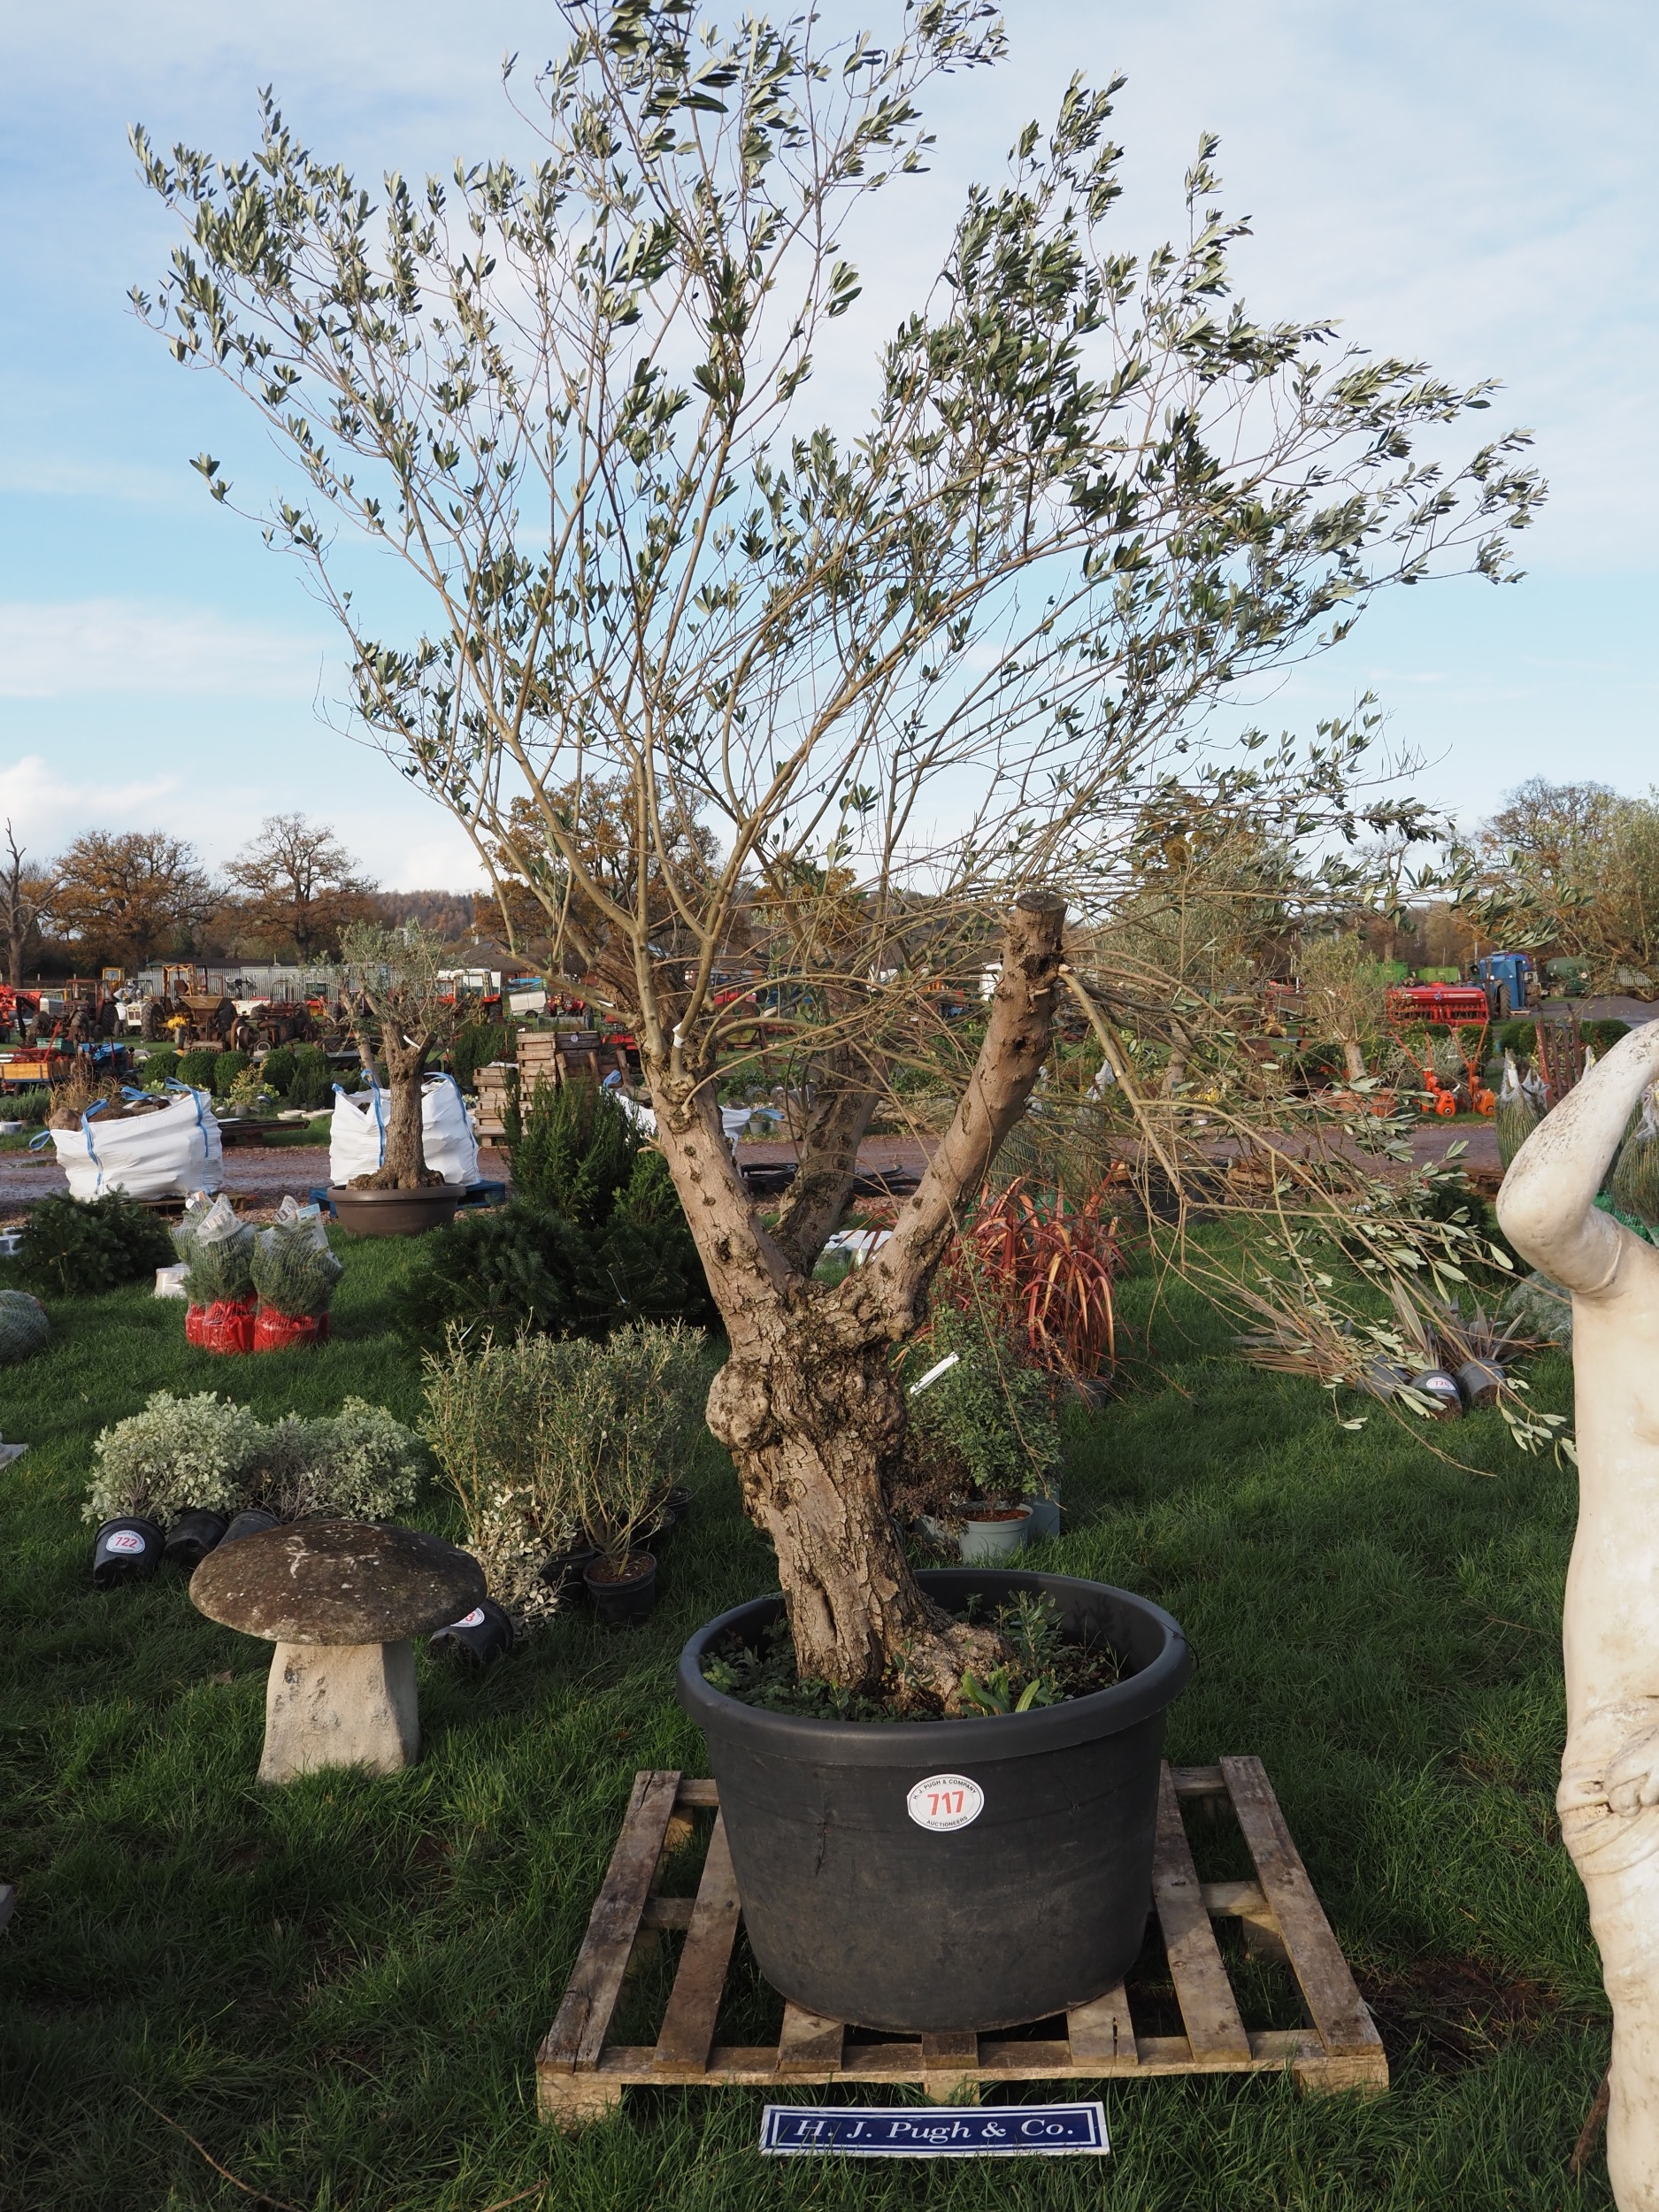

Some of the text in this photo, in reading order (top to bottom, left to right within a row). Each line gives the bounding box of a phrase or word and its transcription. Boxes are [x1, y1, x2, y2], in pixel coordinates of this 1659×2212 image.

[115, 1536, 137, 1548] 722
[924, 1779, 941, 1789] PUGH
[949, 1778, 977, 1794] COMPANY
[926, 1790, 964, 1816] 717
[926, 1816, 968, 1827] AUCTIONEERS
[794, 2118, 1074, 2145] H. J. Pugh & Co.
